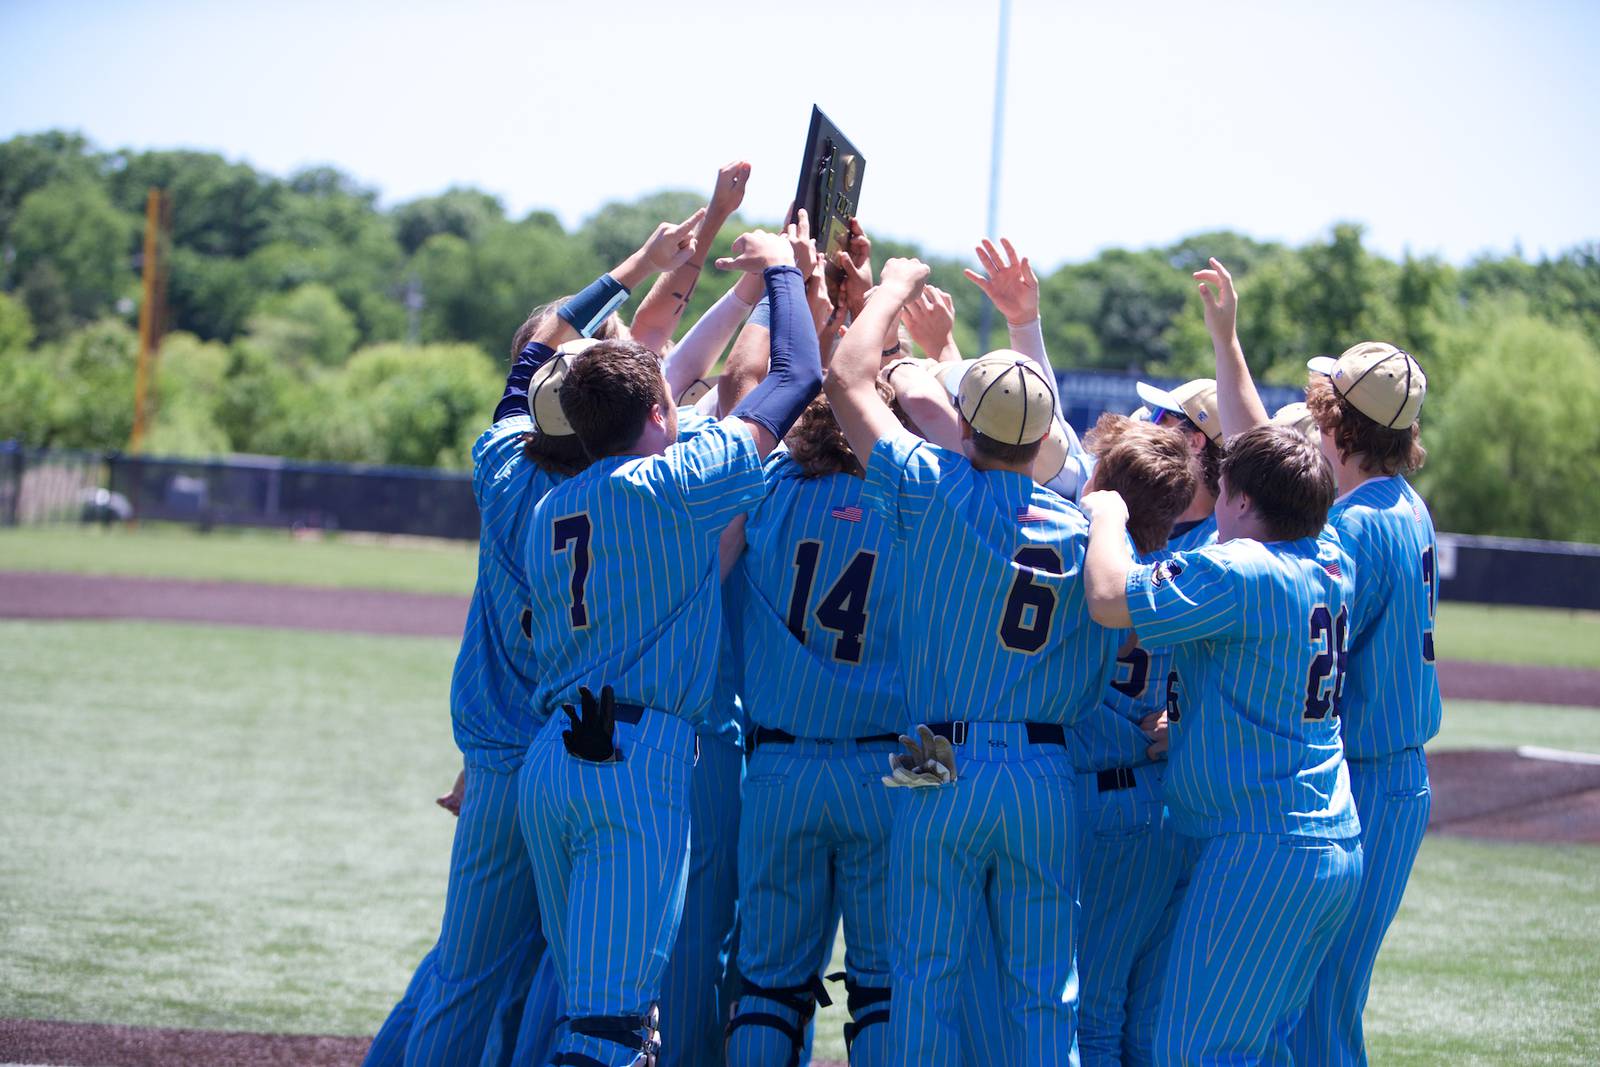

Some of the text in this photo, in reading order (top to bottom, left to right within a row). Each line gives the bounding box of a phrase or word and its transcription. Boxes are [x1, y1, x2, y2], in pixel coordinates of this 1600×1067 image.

[552, 511, 592, 631] 7
[787, 538, 879, 665] 14
[996, 544, 1064, 656] 6
